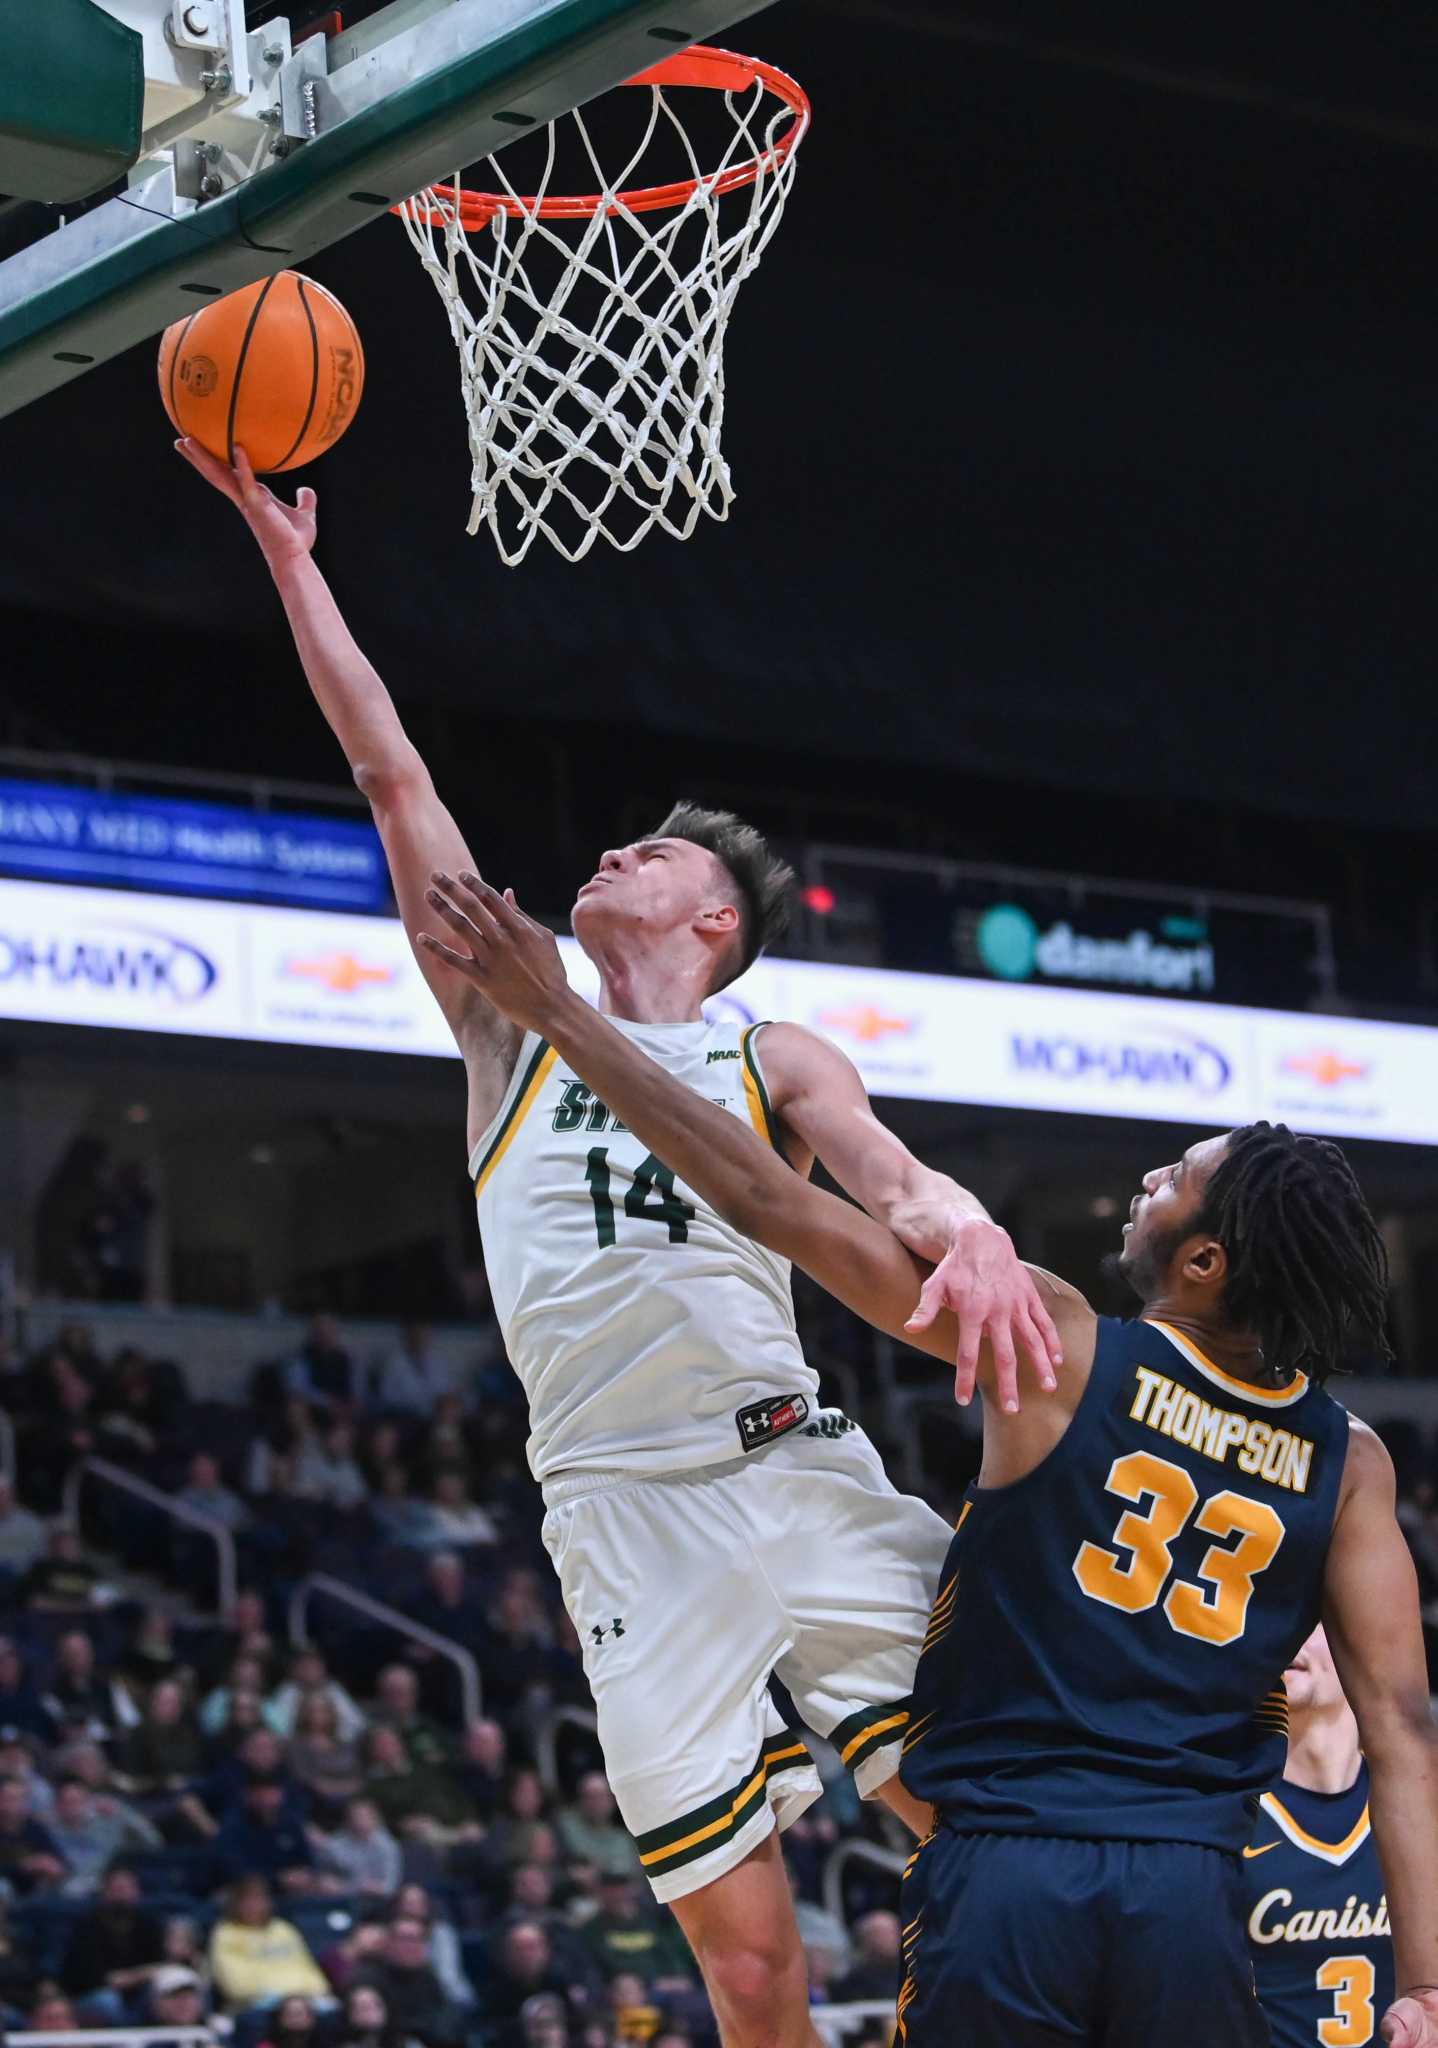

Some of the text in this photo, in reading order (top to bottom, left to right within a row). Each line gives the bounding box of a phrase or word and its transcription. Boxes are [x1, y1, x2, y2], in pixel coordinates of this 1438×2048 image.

[706, 1049, 742, 1066] MAAC
[584, 1146, 696, 1250] 14
[1129, 1365, 1315, 1494] THOMPSON
[1072, 1450, 1286, 1647] 33
[1249, 1887, 1392, 1945] Canisi
[1316, 1955, 1376, 2048] 3
